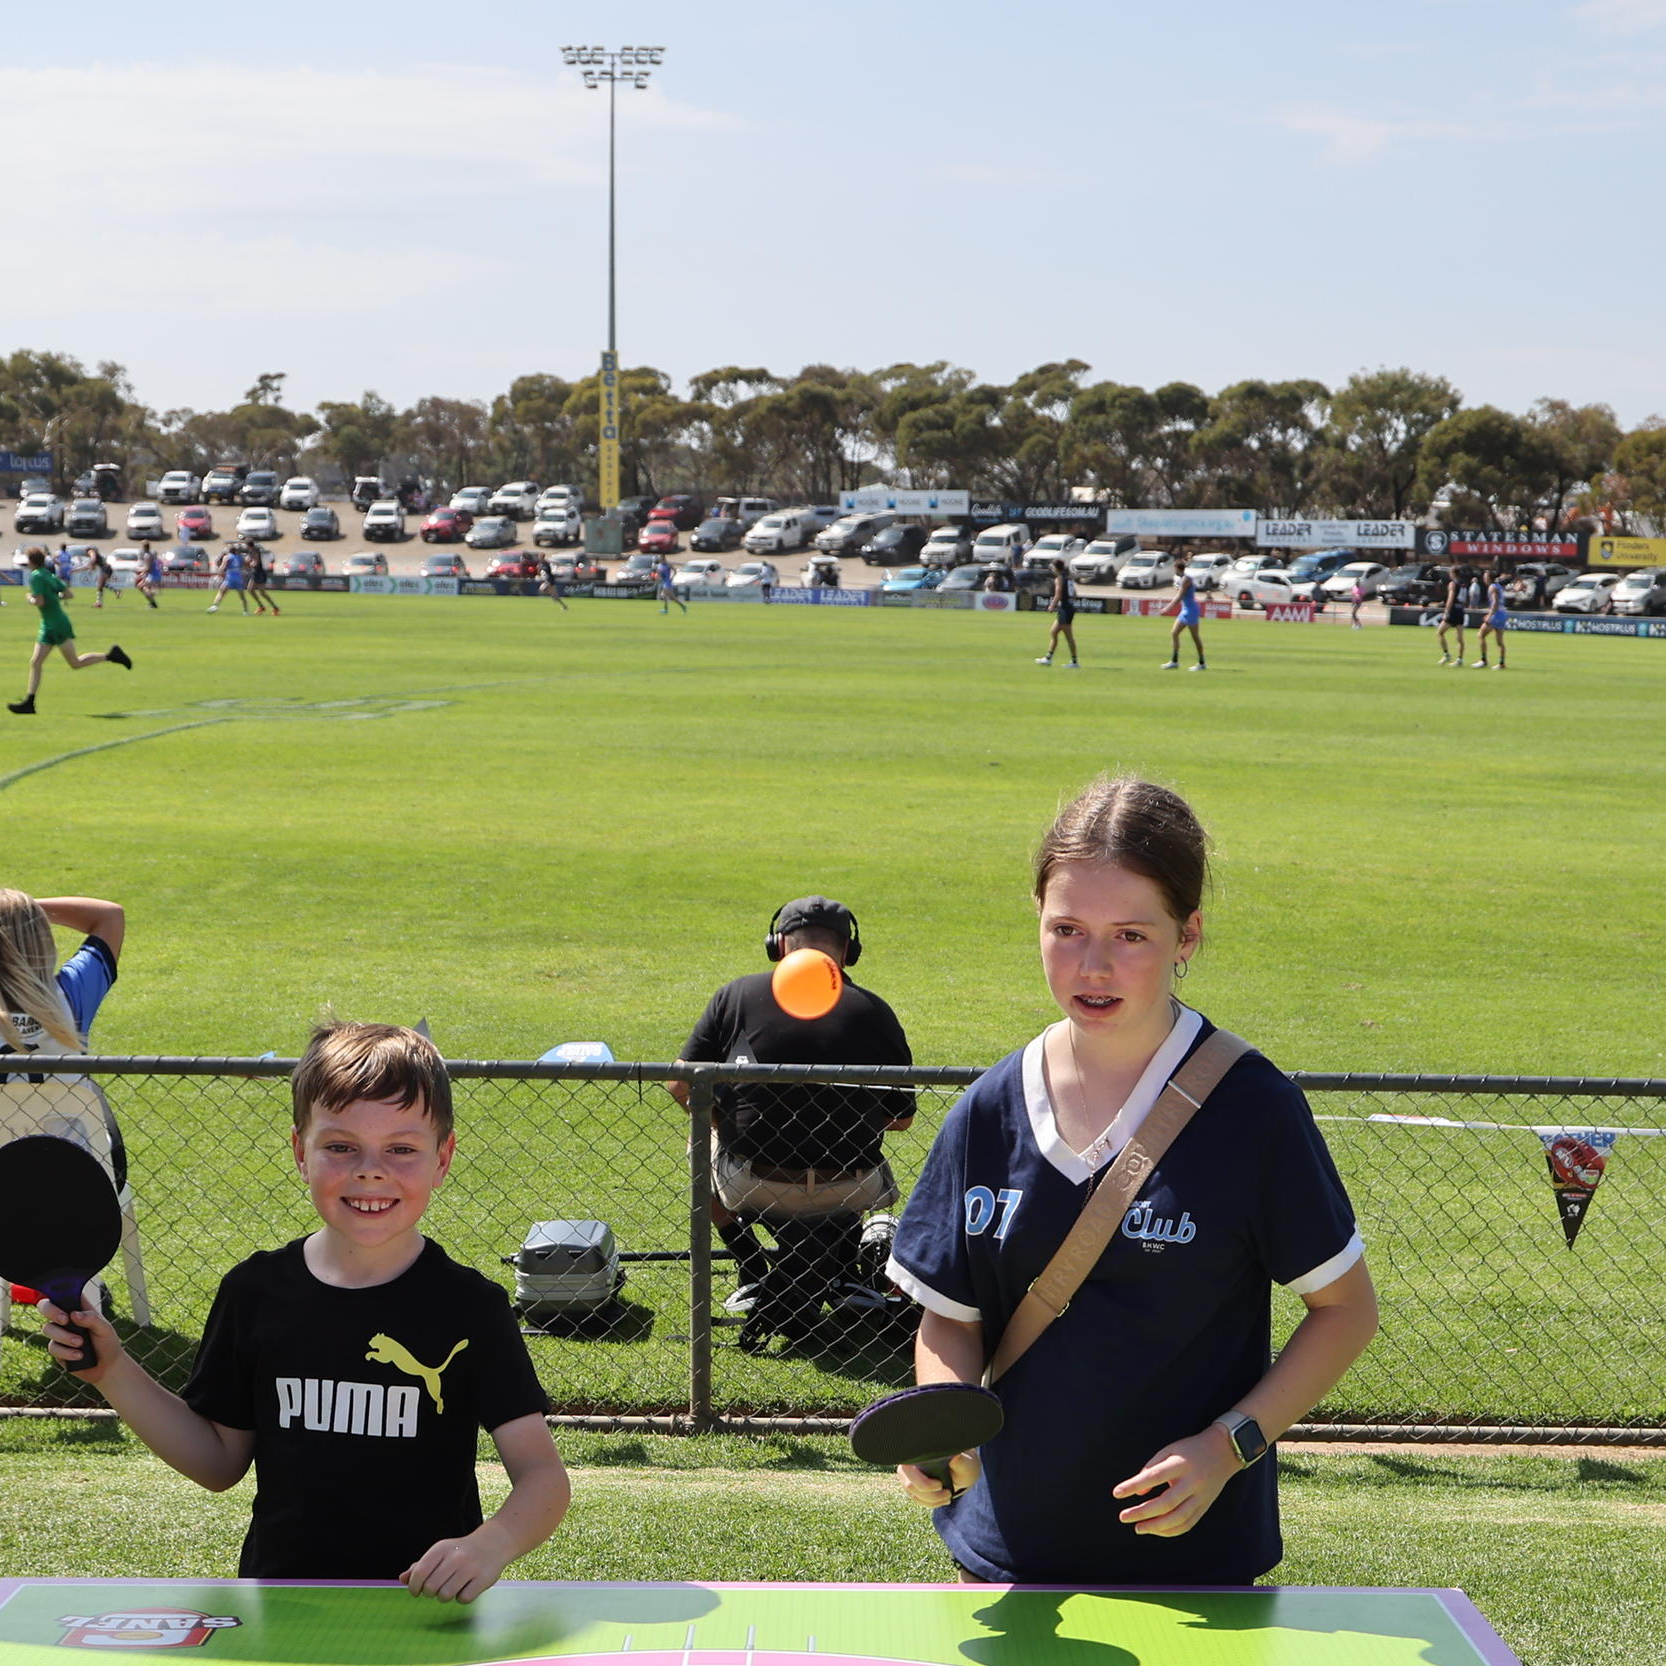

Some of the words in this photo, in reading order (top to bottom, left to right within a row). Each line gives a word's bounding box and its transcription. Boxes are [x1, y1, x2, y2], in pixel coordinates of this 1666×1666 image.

[1265, 523, 1312, 537] LEADER
[1357, 523, 1405, 537] LEADER
[1450, 530, 1579, 546] STATESMAN
[1467, 543, 1562, 556] WINDOWS
[769, 588, 812, 600] LEADER
[820, 589, 865, 602] LEADER
[1270, 606, 1311, 623] AAMI
[1515, 616, 1562, 631] HOSTPLUS
[1592, 620, 1636, 636] HOSTPLUS
[964, 1184, 1024, 1240] 07
[1121, 1207, 1197, 1244] Club
[276, 1377, 421, 1438] PUMA
[58, 1614, 243, 1630] SANFL
